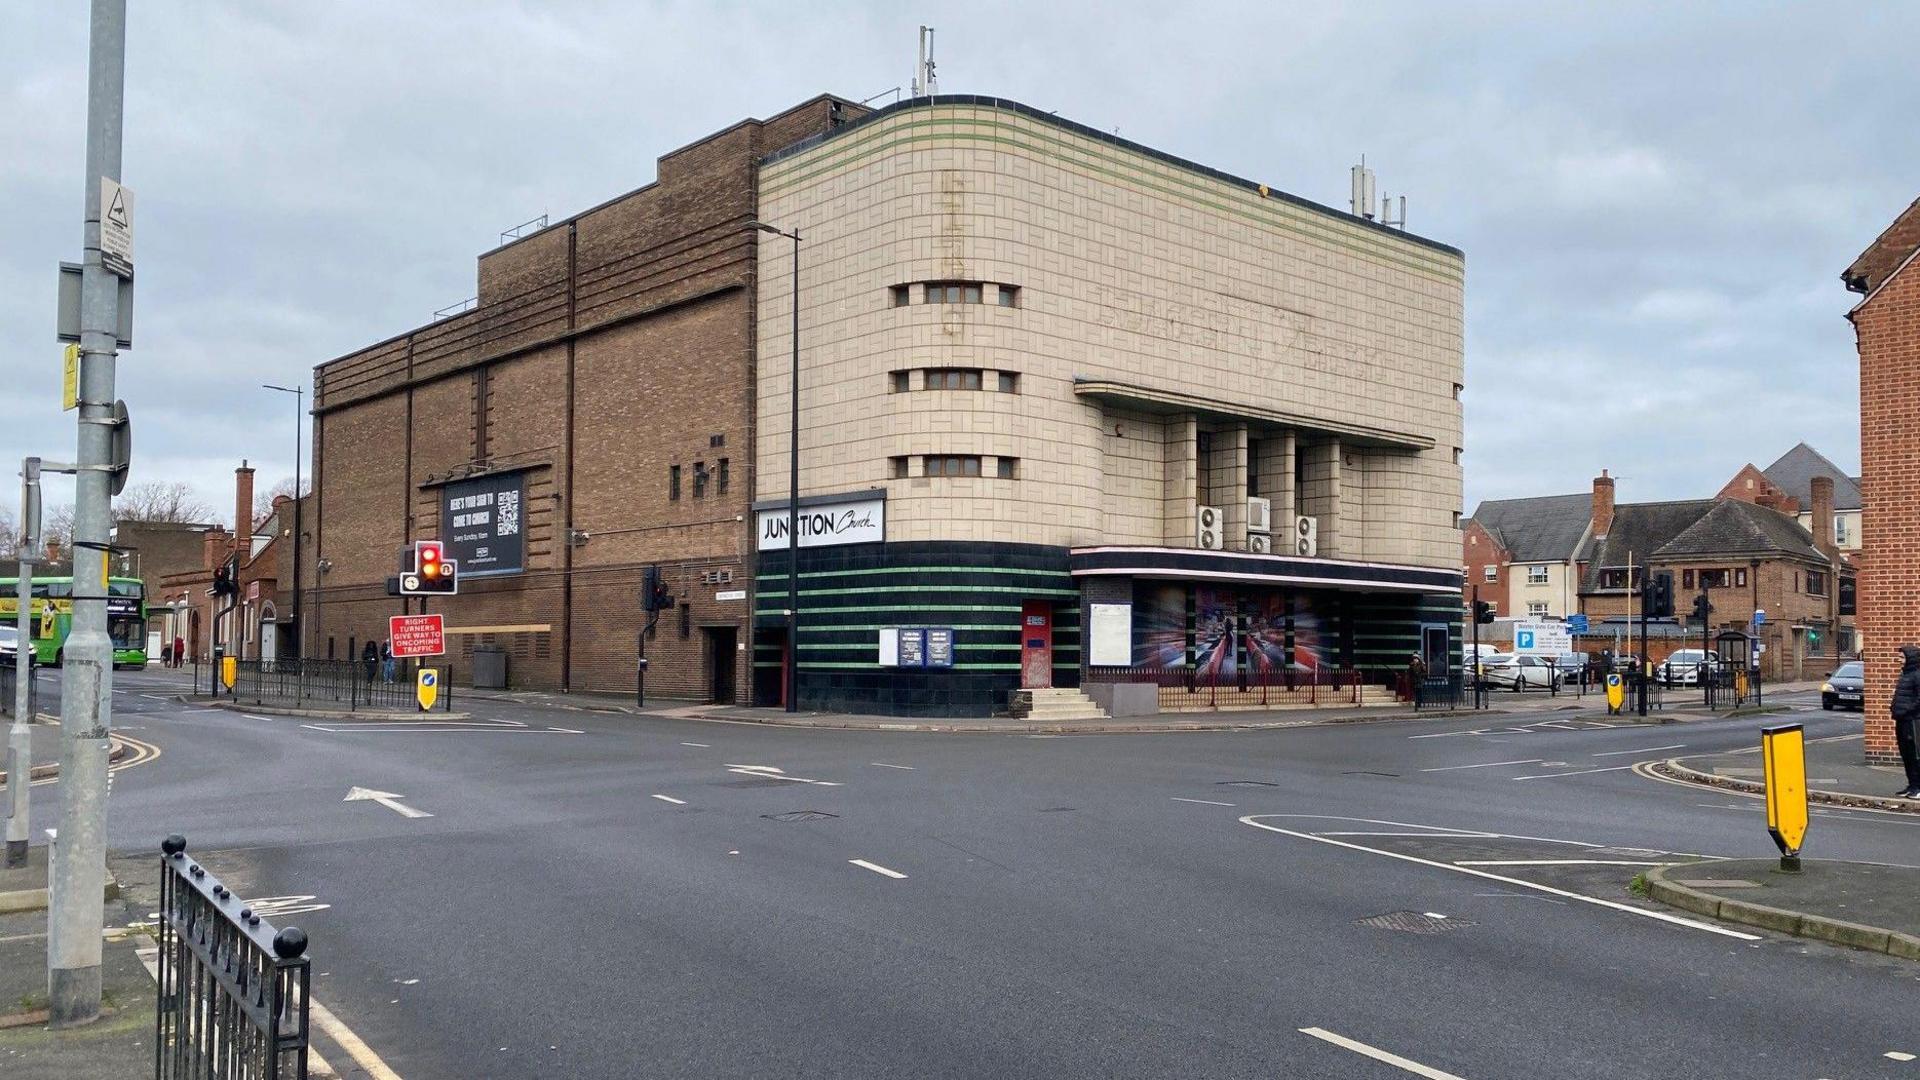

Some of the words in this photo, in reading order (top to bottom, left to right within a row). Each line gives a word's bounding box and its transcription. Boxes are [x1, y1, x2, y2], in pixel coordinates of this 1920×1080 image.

[450, 498, 464, 510] HERE'S
[465, 496, 476, 508] YOUR
[476, 494, 487, 506] SIGN
[487, 493, 493, 505] TO
[453, 515, 465, 527] COME
[466, 514, 471, 526] TO
[472, 512, 489, 525] CHURCH
[765, 513, 834, 539] JUNTION
[396, 638, 440, 646] ONCOMING
[1521, 634, 1530, 646] P
[403, 645, 434, 653] TRAFFIC
